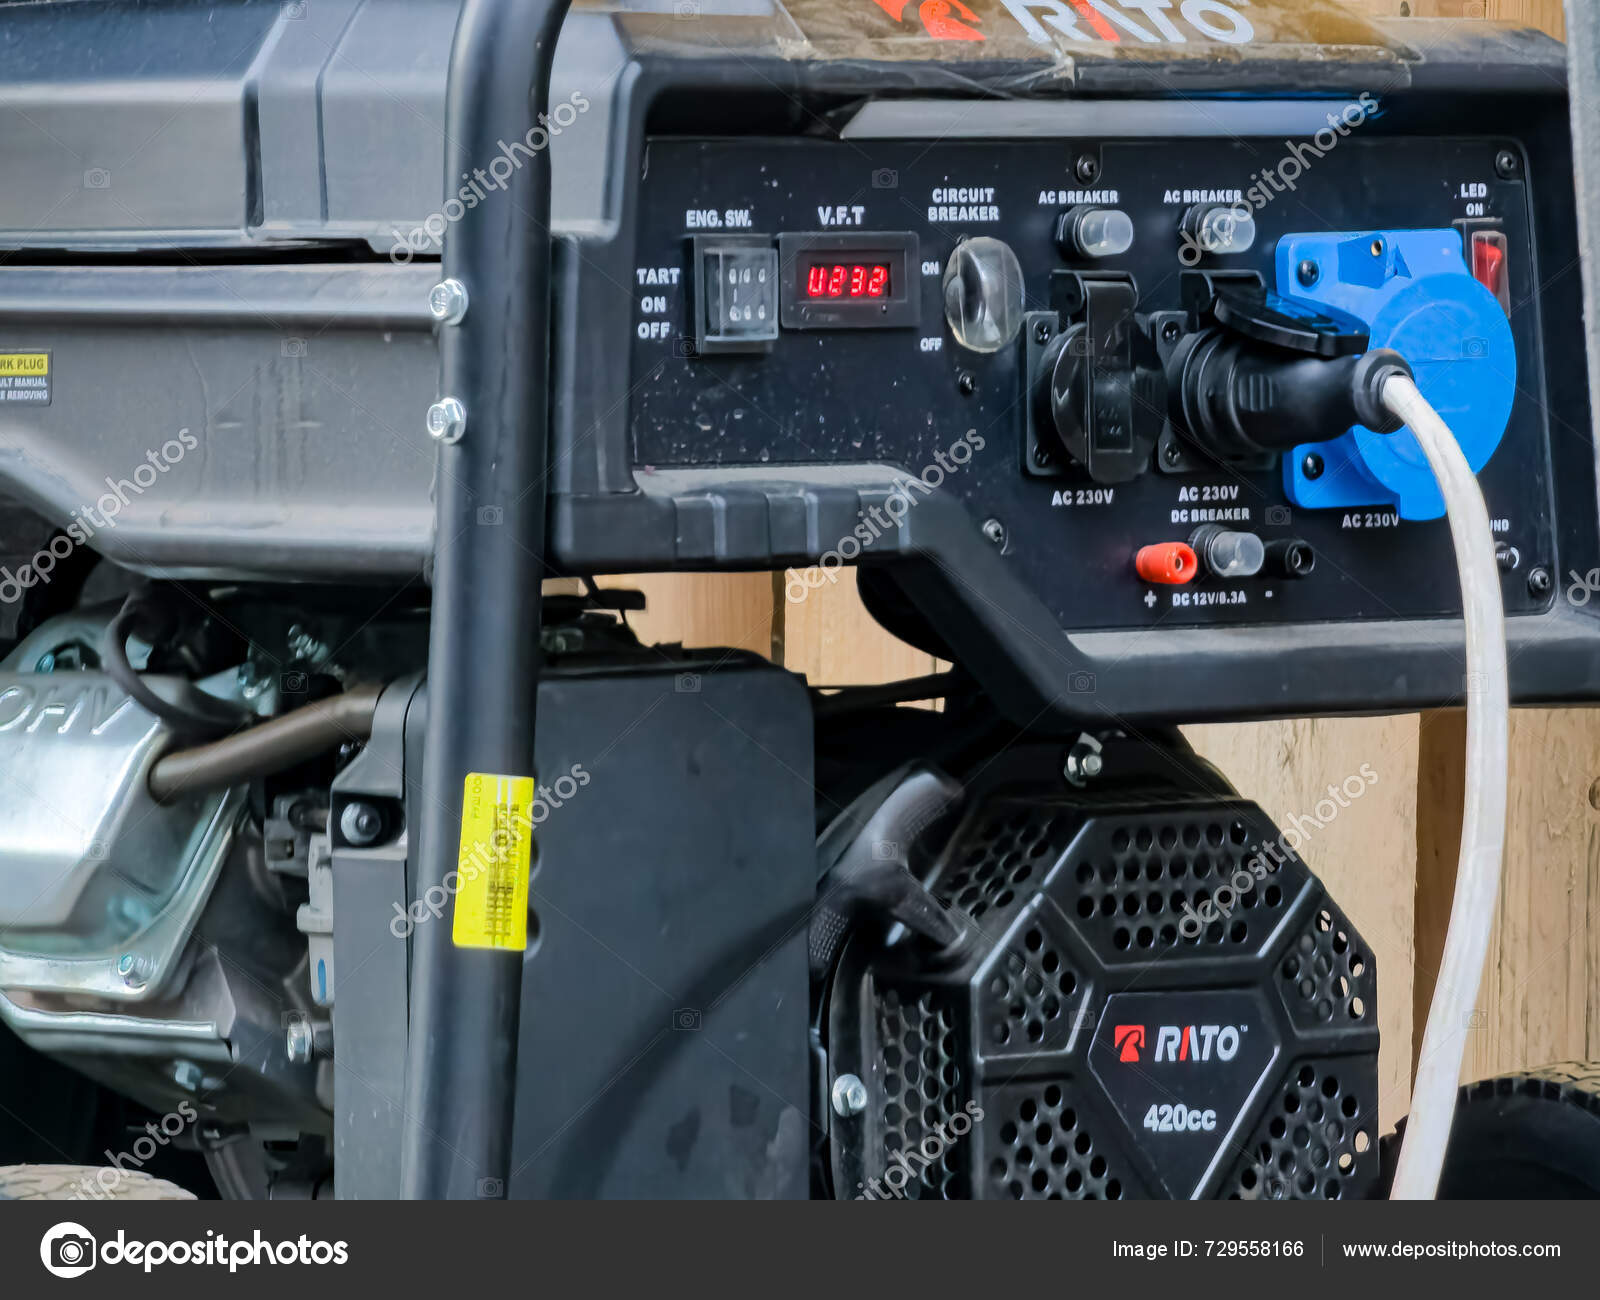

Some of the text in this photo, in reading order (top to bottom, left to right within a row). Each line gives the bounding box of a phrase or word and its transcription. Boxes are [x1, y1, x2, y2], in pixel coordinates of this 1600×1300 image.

[1001, 0, 1254, 44] RATO
[932, 187, 994, 203] CIRCUIT
[1038, 190, 1119, 204] AC BREAKER
[1163, 189, 1242, 203] AC BREAKER
[1460, 183, 1487, 198] LED
[817, 206, 865, 225] V.F.T
[927, 206, 999, 222] BREAKER
[1465, 202, 1484, 216] ON
[686, 209, 752, 228] ENG. SW.
[636, 267, 681, 285] TART
[921, 261, 939, 275] ON
[641, 296, 666, 313] ON
[637, 322, 670, 339] OFF
[919, 337, 942, 351] OFF
[16, 358, 44, 370] PLUG
[1051, 489, 1114, 506] AC 230V
[1178, 485, 1239, 502] AC 230V
[1171, 507, 1250, 523] DC BREAKER
[1342, 513, 1399, 528] AC 230V
[1172, 592, 1190, 607] DC
[1154, 1025, 1240, 1062] RATO
[1143, 1103, 1217, 1132] 420cc
